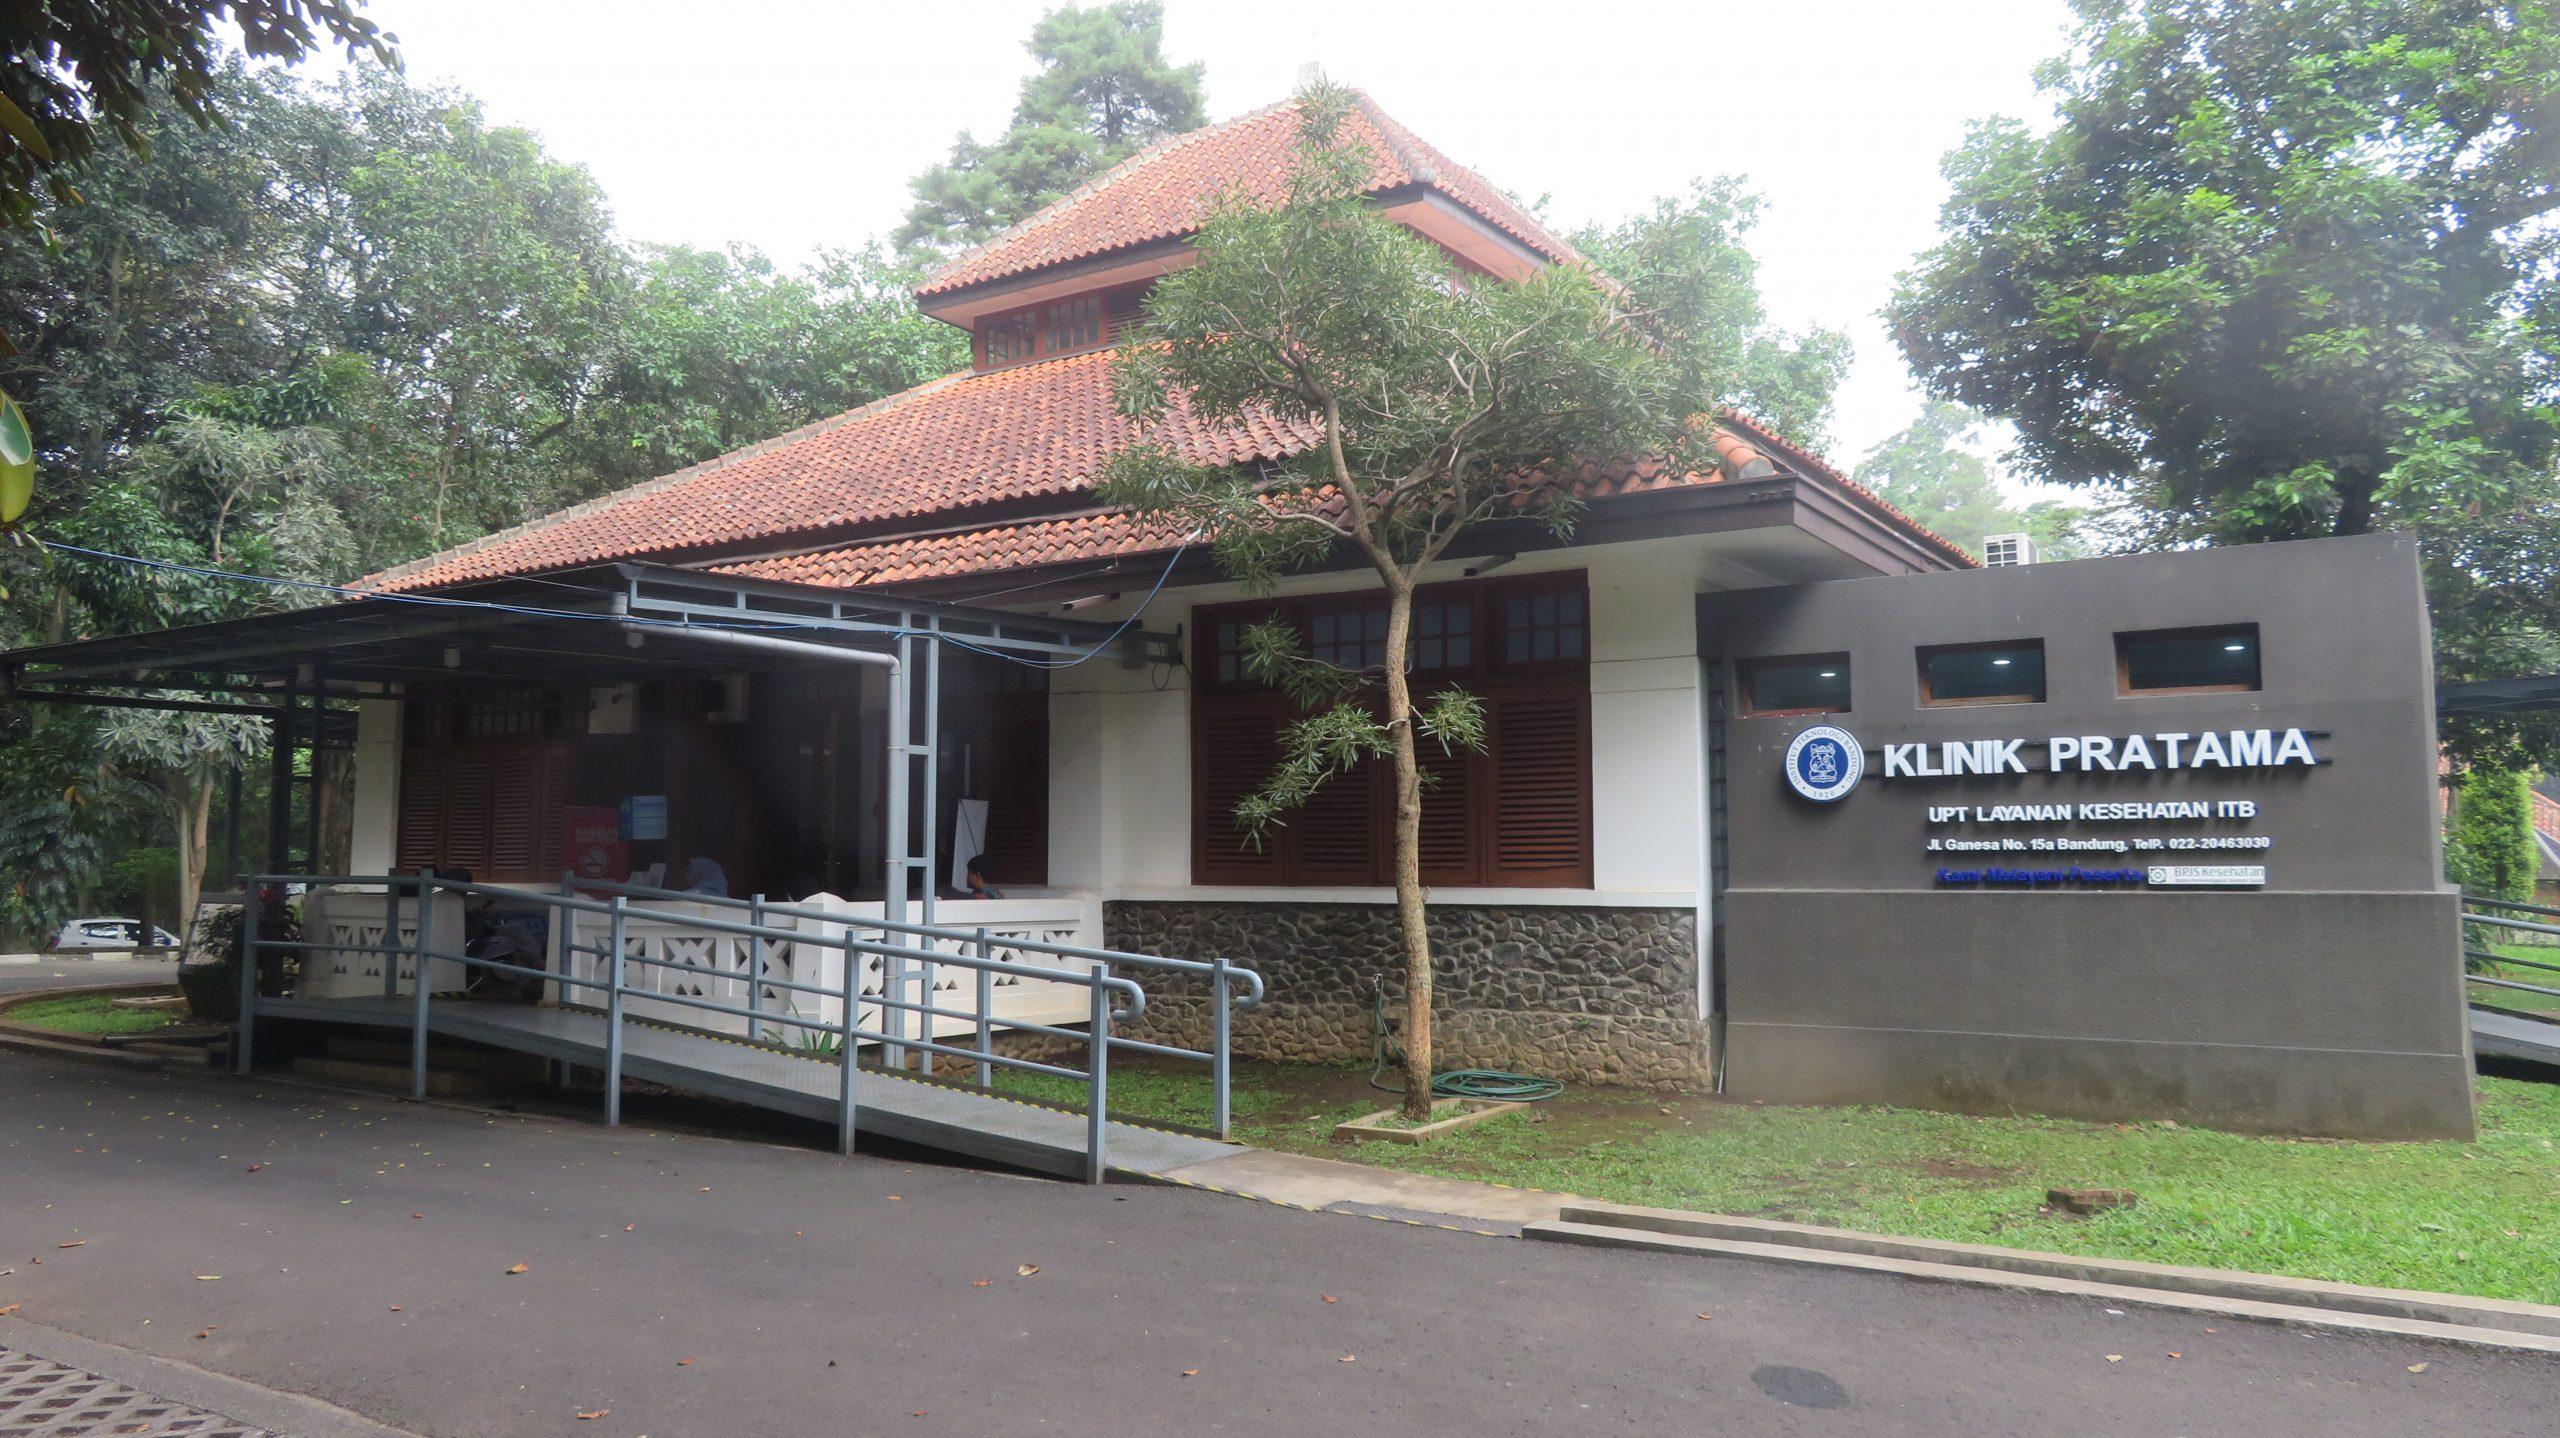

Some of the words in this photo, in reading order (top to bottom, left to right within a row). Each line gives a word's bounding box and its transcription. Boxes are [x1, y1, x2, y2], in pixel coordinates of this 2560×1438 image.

[1788, 746, 1801, 785] INSTITUT
[1798, 728, 1845, 745] TEKNOLOGI
[1844, 740, 1858, 783] BANDUNG
[1884, 738, 2028, 777] KLINIK
[2050, 727, 2315, 772] PRATAMA
[1928, 806, 1969, 822] UPT
[1976, 804, 2072, 822] LAYANAN
[2079, 801, 2209, 820] KESEHATAN
[2218, 800, 2256, 818] ITB
[1945, 838, 2000, 850] Ganesa
[2002, 838, 2027, 850] No.
[2030, 838, 2054, 850] 15a
[2057, 838, 2128, 853] Bandung,
[2169, 836, 2270, 849] 022-20463030
[1937, 866, 1979, 882] Kami
[1986, 866, 2064, 885] Melayani
[2070, 865, 2143, 882] Peserta
[2174, 867, 2199, 877] BPJS
[2202, 867, 2264, 877] Kesehatan
